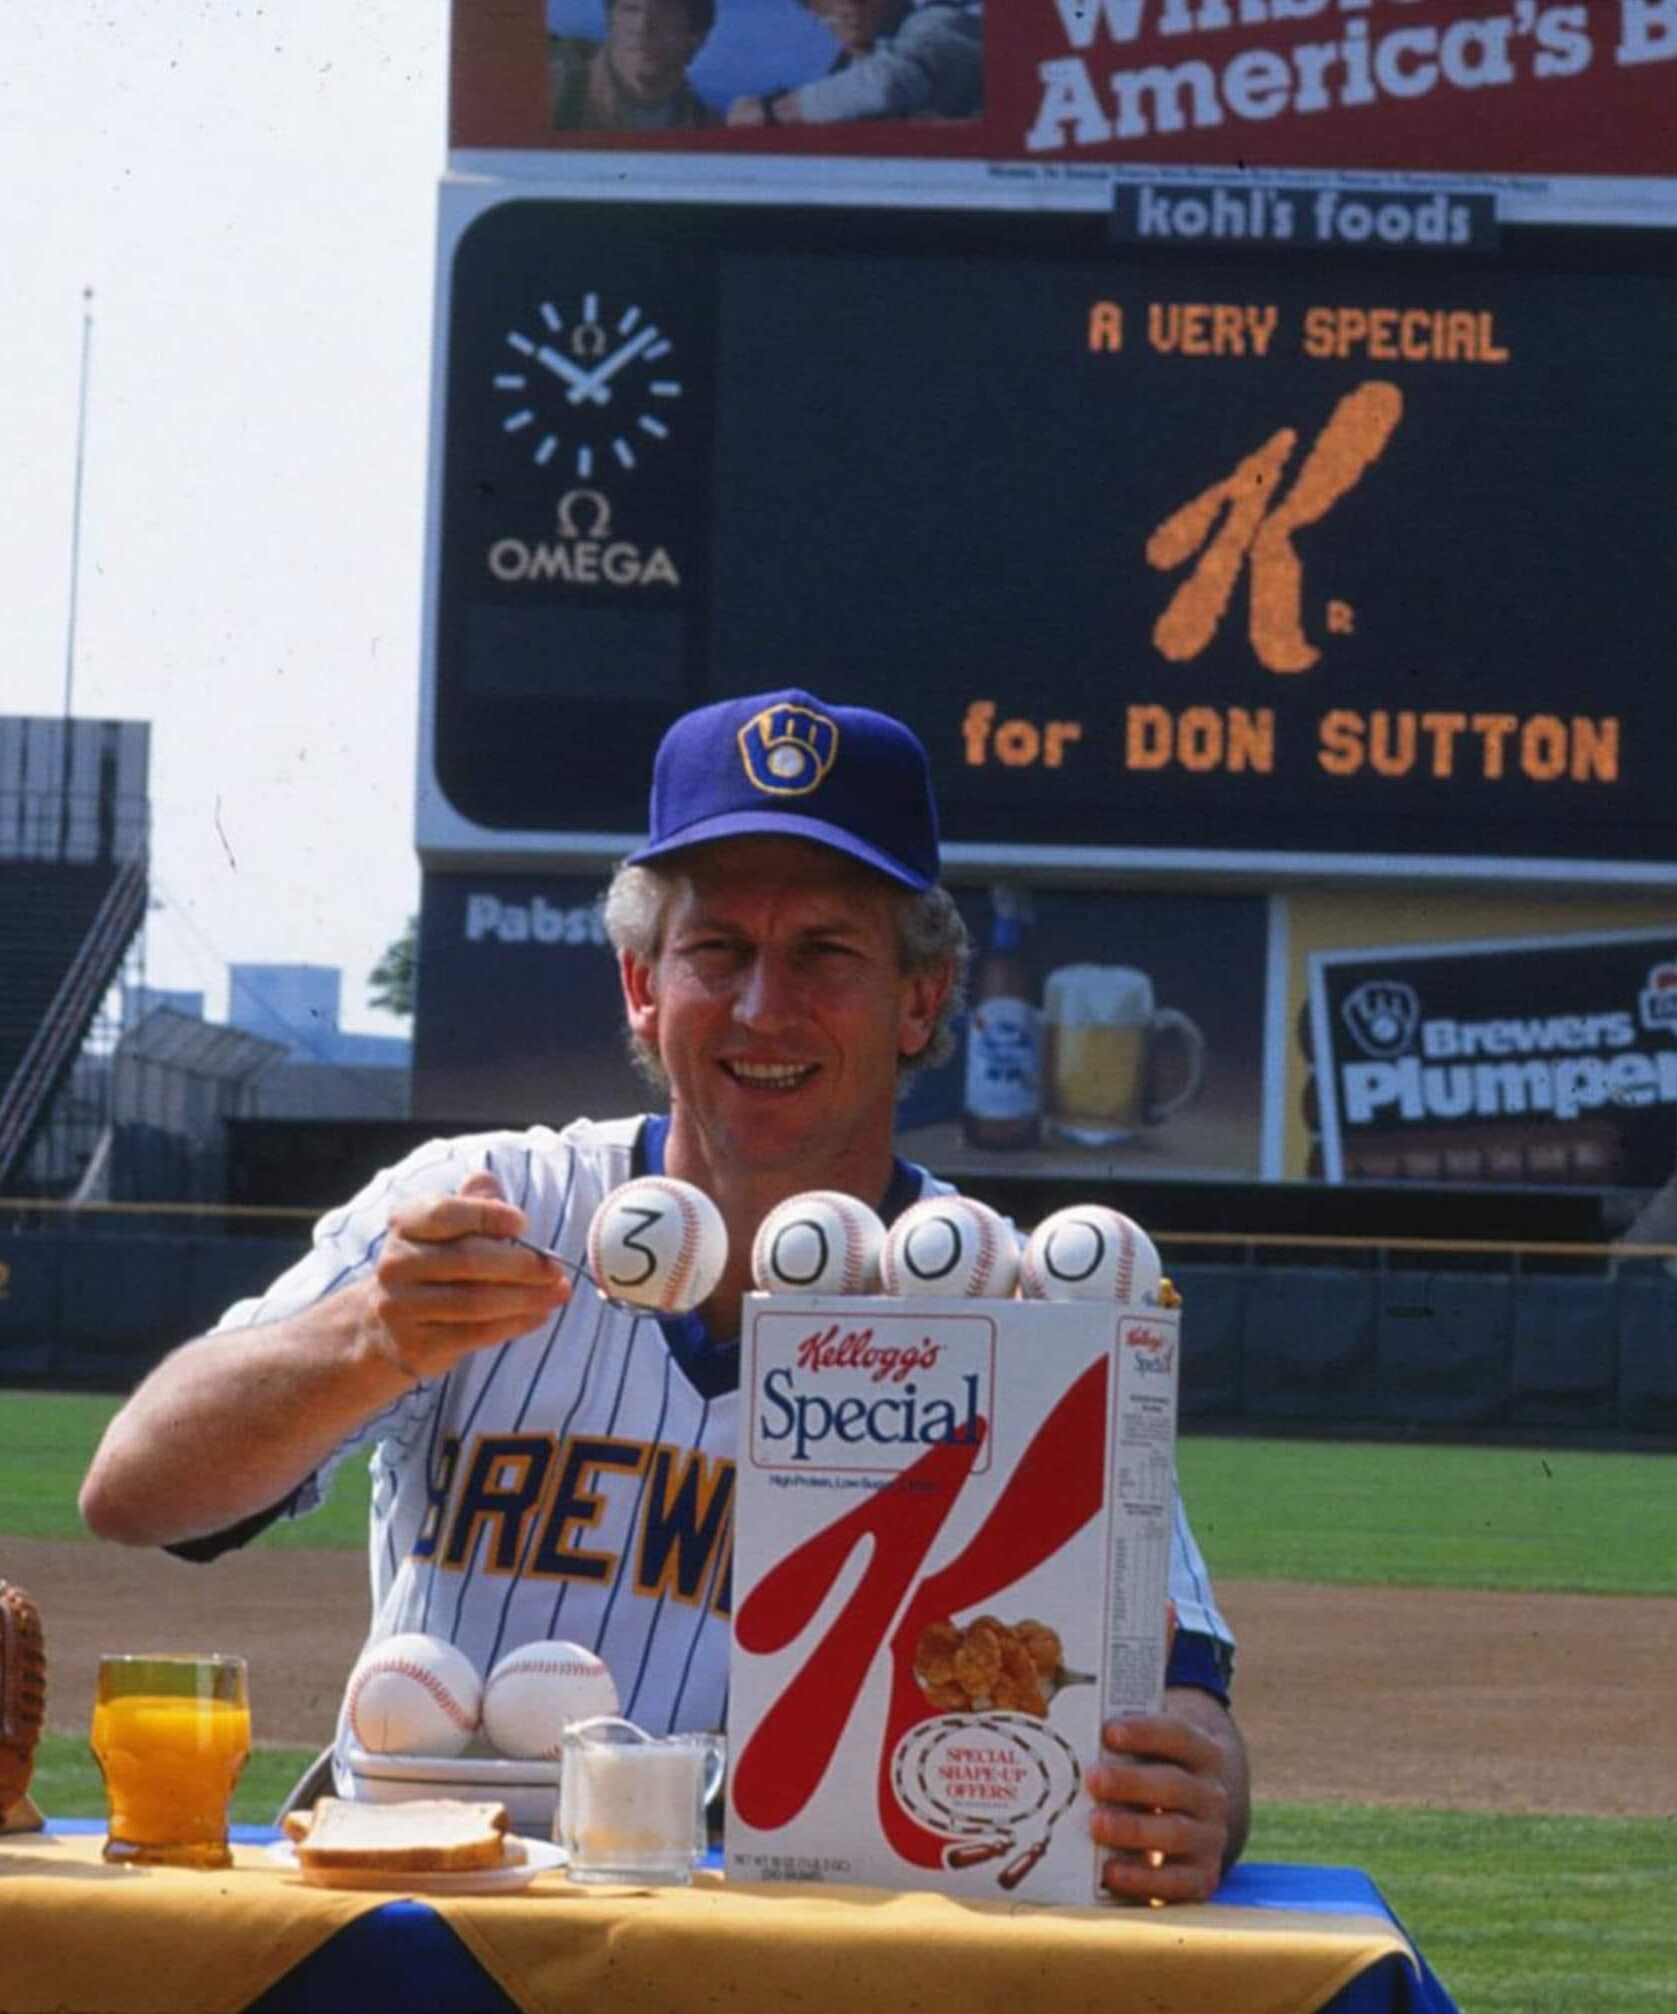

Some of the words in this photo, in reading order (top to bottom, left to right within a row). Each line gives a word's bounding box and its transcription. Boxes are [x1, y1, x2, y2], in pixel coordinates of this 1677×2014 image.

[1026, 0, 1592, 151] America's
[1615, 0, 1677, 66] B
[1138, 187, 1294, 238] kohl's
[1314, 191, 1471, 244] foods
[1089, 302, 1122, 352] A
[1148, 304, 1278, 356] VERY
[1304, 307, 1509, 362] SPECIAL
[488, 538, 681, 586] OMEGA
[963, 702, 1081, 767] for
[1126, 705, 1275, 772] DON
[1318, 710, 1620, 781] SUTTON
[1422, 1011, 1636, 1057] Brewers
[609, 1208, 663, 1287] 3
[797, 1323, 941, 1383] Kellogg's
[761, 1368, 983, 1460] Special
[408, 1430, 736, 1622] REW
[938, 1766, 1027, 1782] SHAPE-UP
[946, 1747, 1020, 1764] SPECIAL
